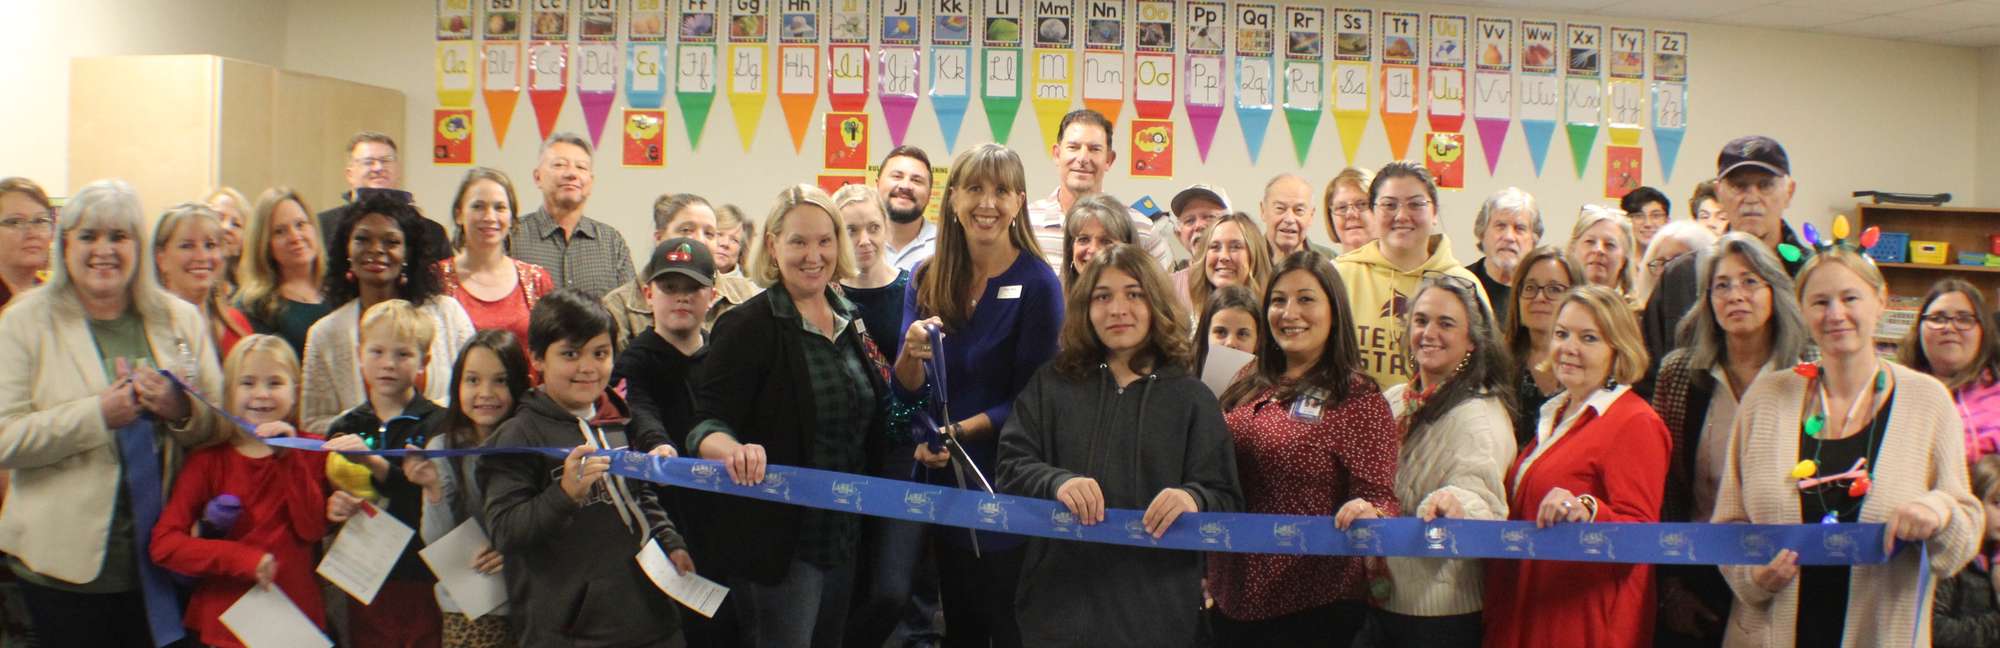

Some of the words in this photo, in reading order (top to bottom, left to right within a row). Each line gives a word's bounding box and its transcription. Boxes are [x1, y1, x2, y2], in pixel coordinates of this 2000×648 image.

[737, 0, 760, 14] Gg
[788, 0, 810, 11] Hh
[895, 0, 907, 15] Jj
[940, 0, 963, 13] Kk
[1039, 2, 1069, 15] Mm
[1092, 2, 1116, 17] Nn
[1142, 4, 1168, 20] Oo
[1195, 7, 1217, 26] Pp
[1243, 10, 1268, 29] Qq
[1294, 12, 1314, 28] Rr
[1344, 14, 1362, 30] Ss
[1392, 18, 1409, 33] Tt
[1436, 20, 1457, 37] Uu
[1483, 24, 1505, 40] Vv
[1526, 27, 1552, 41] Ww
[1573, 30, 1594, 45] Xx
[1618, 33, 1636, 51] Yy
[1662, 36, 1680, 52] Zz
[937, 55, 965, 80] Kk
[1192, 63, 1218, 101] Pp
[1358, 325, 1402, 350] TEX
[1360, 349, 1406, 375] STA
